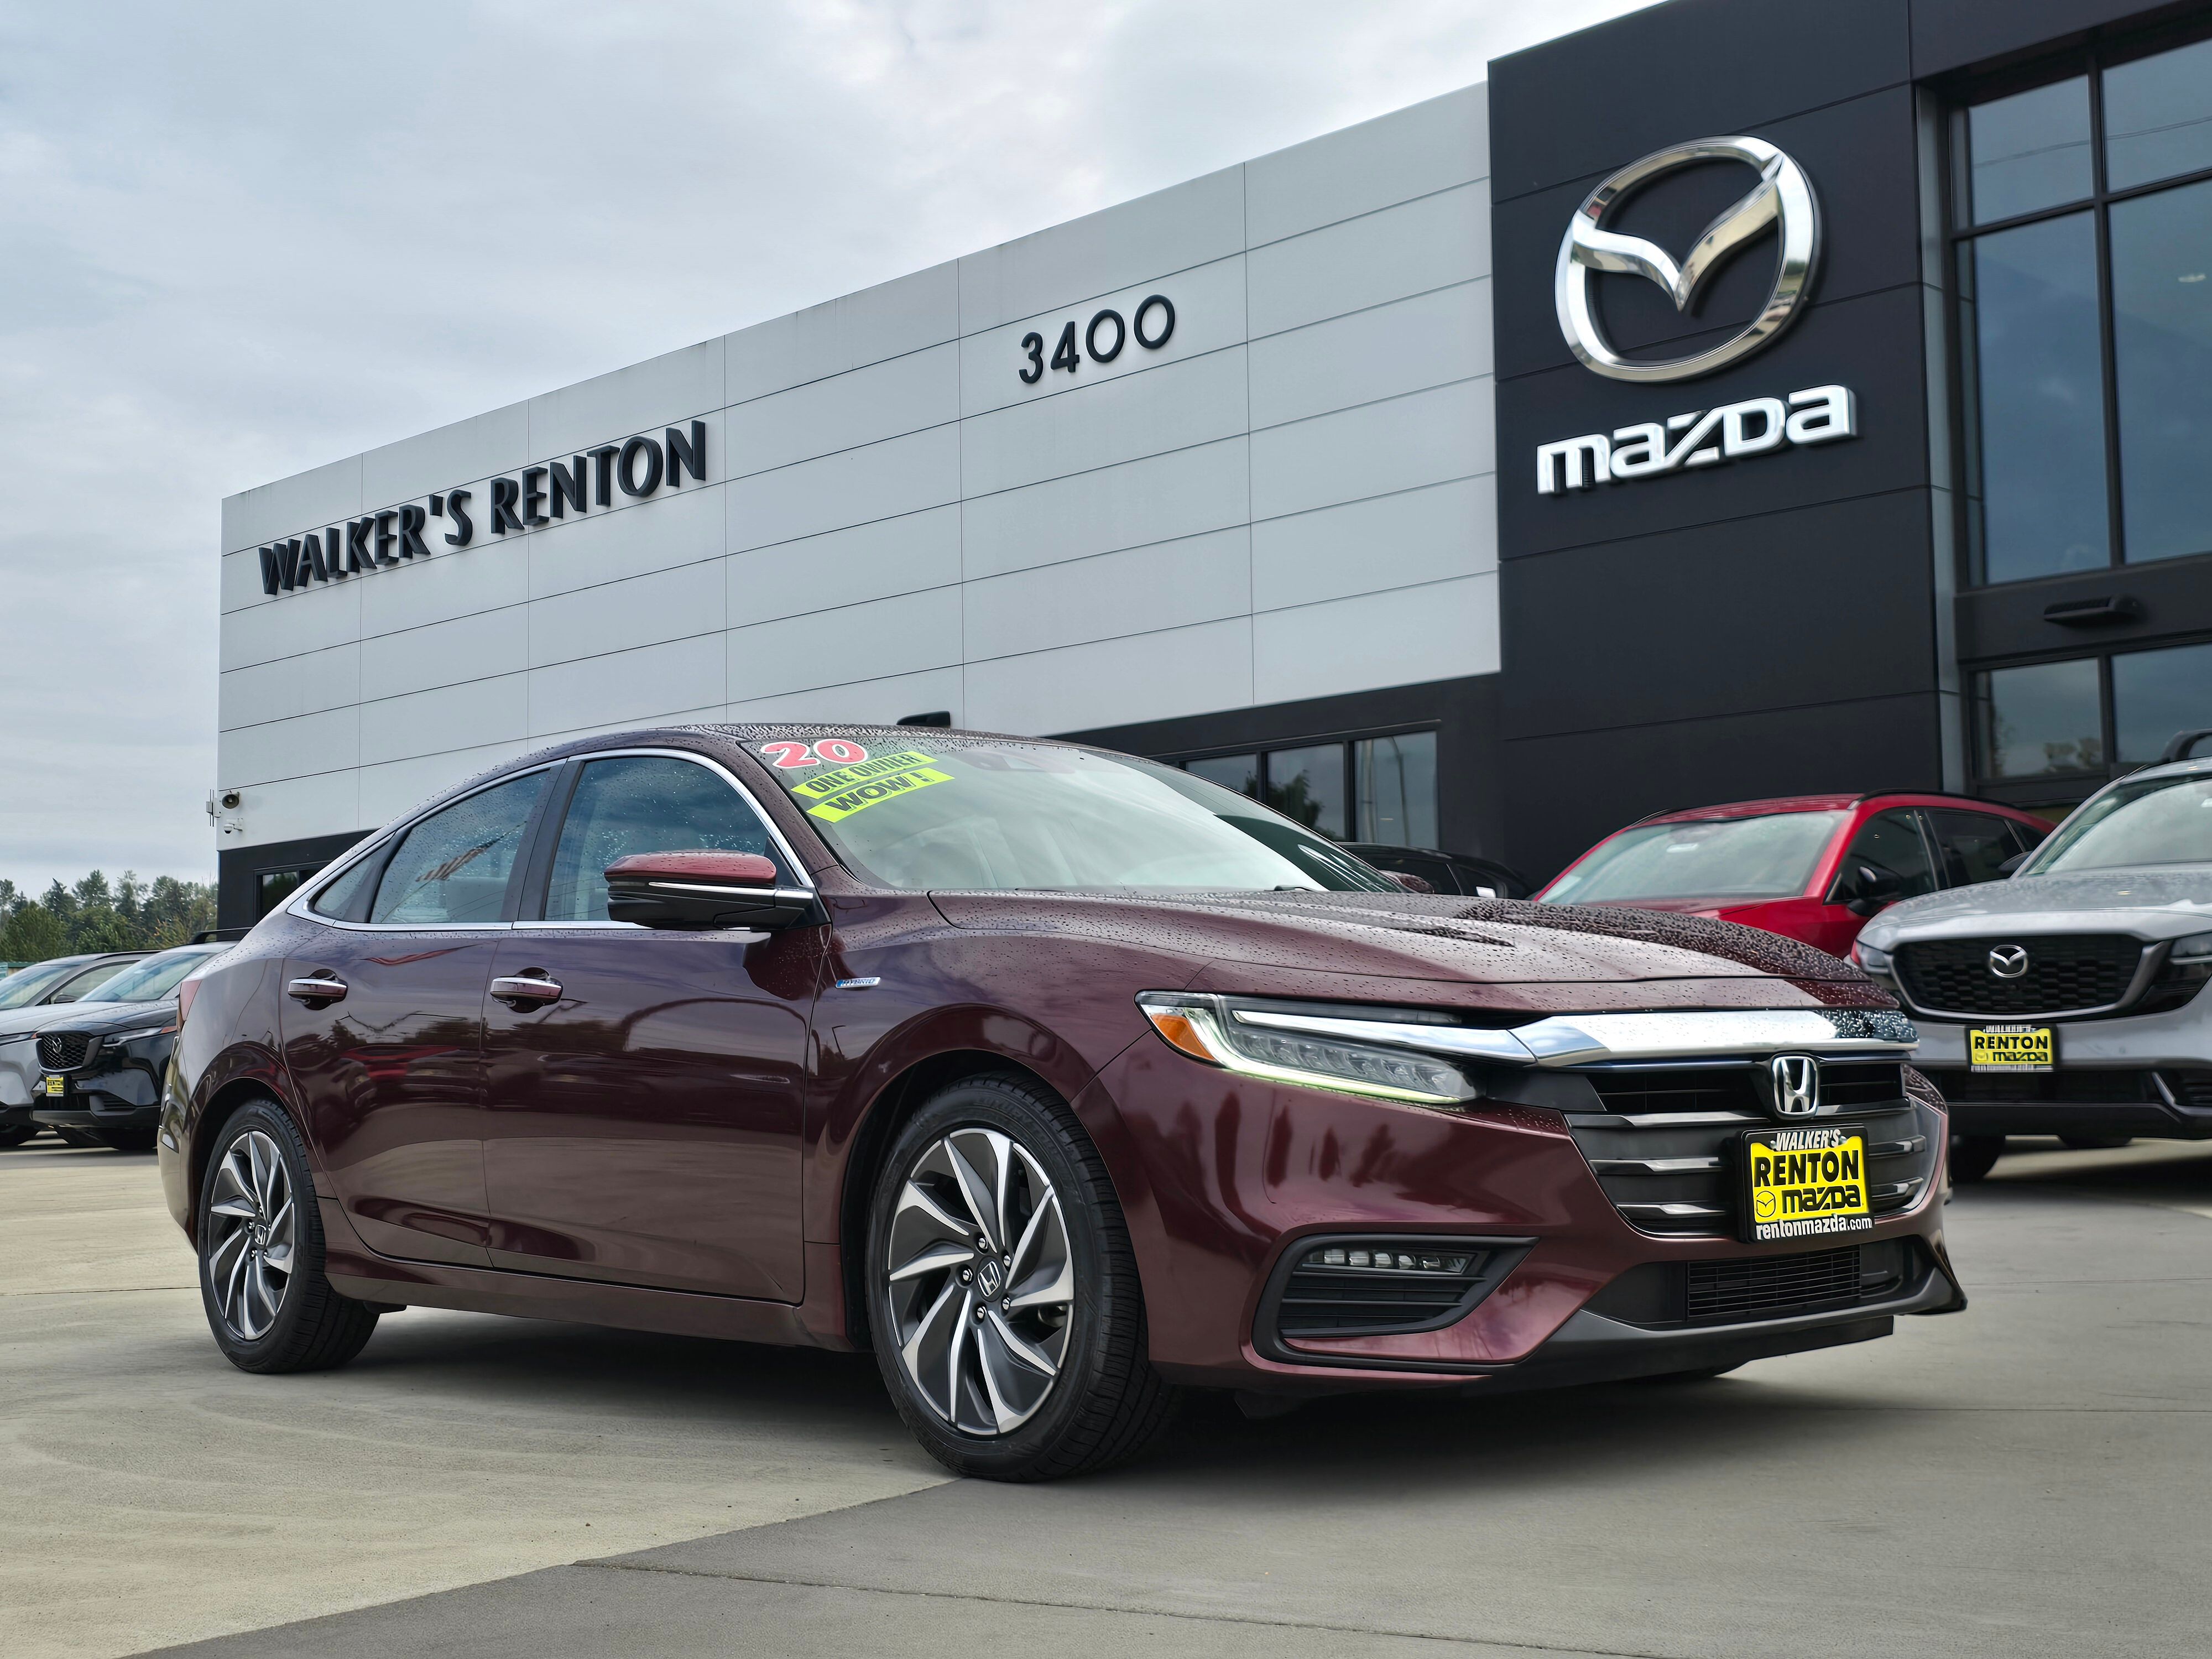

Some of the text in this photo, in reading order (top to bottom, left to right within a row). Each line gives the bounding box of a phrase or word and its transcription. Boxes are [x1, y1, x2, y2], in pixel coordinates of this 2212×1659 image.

[1019, 294, 1175, 384] 3400
[259, 420, 706, 595] WALKER'S RENTON
[760, 738, 868, 769] 20
[806, 754, 924, 792] ONE OWNER
[1975, 1036, 2048, 1049] RENTON
[1776, 1129, 1841, 1151] WALKER'S
[1754, 1150, 1859, 1187] RENTON
[1756, 1213, 1873, 1240] rentonmazda.com
